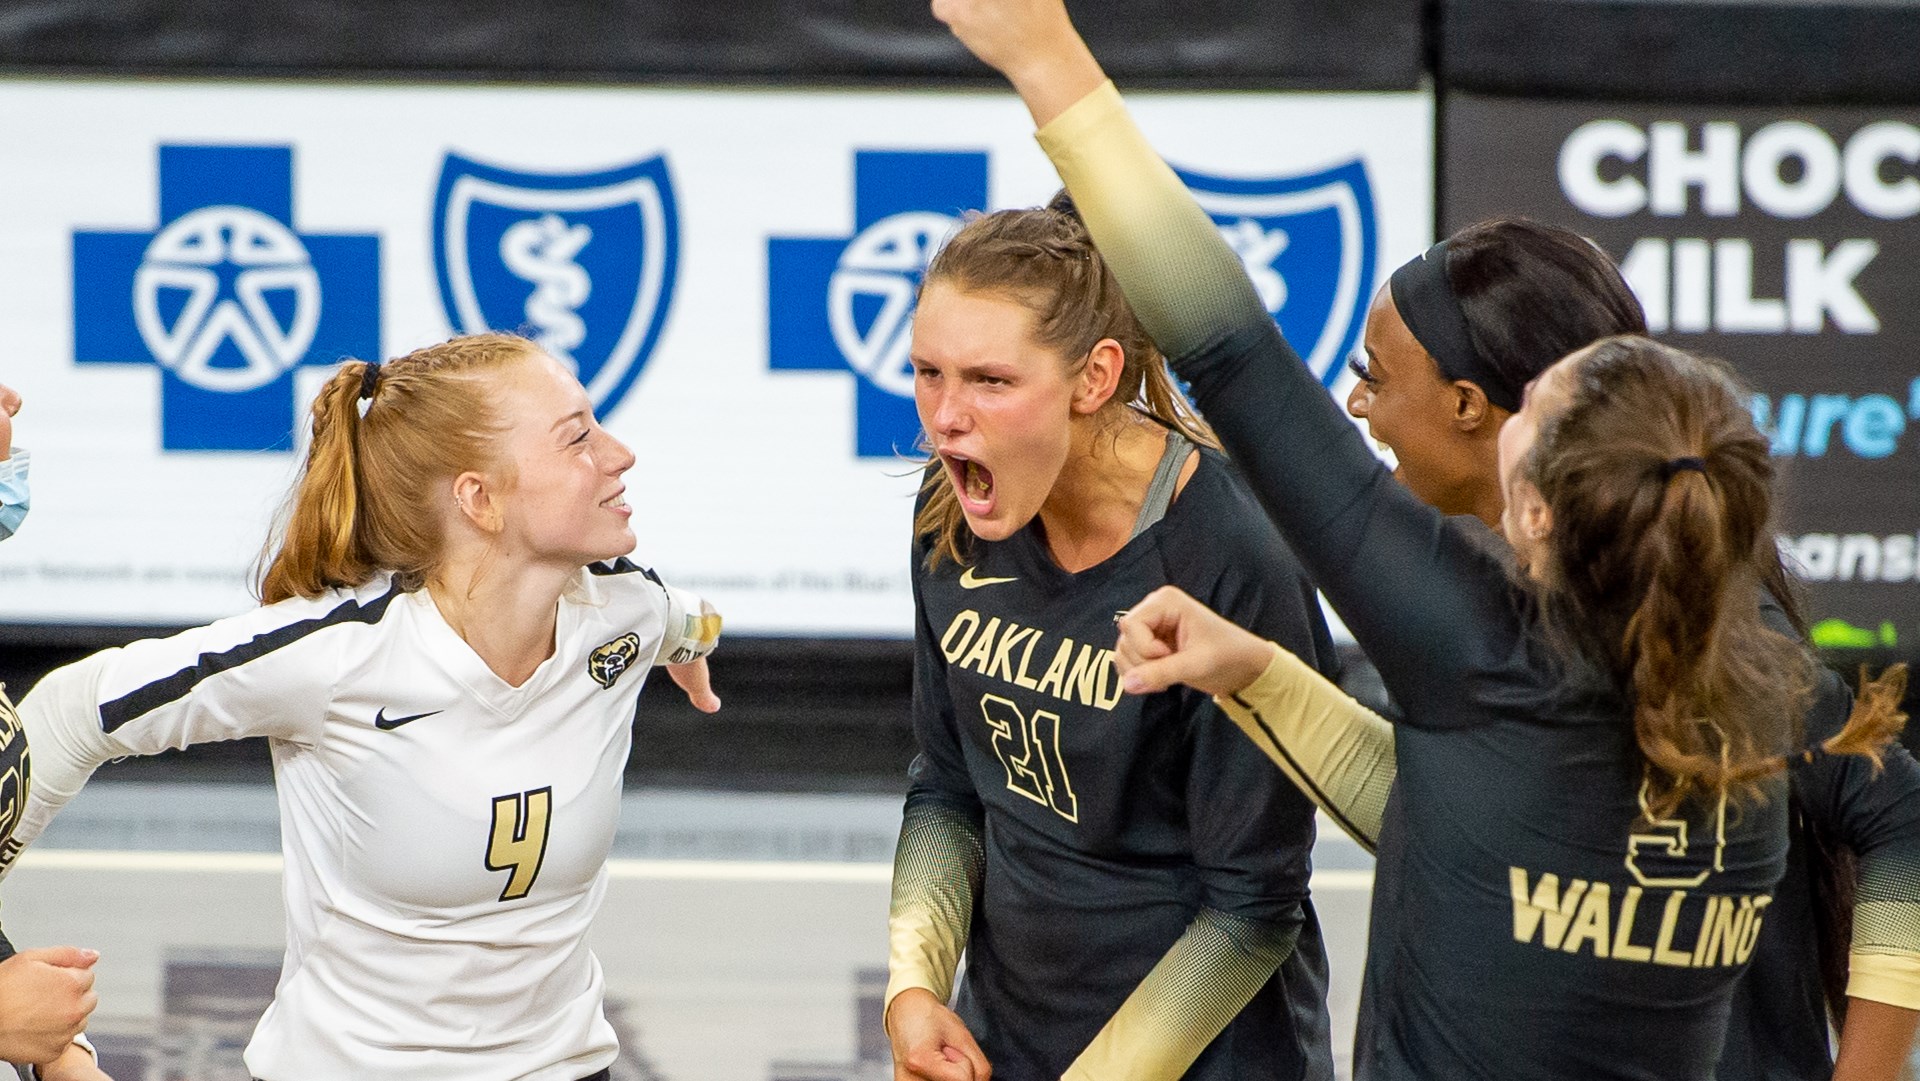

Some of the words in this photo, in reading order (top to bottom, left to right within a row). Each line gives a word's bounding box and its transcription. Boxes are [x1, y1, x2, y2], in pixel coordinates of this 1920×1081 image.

[1557, 119, 1920, 220] CHOC
[1776, 532, 1920, 582] ans
[940, 609, 1124, 711] OAKLAND
[980, 693, 1078, 824] 21
[484, 785, 552, 902] 4
